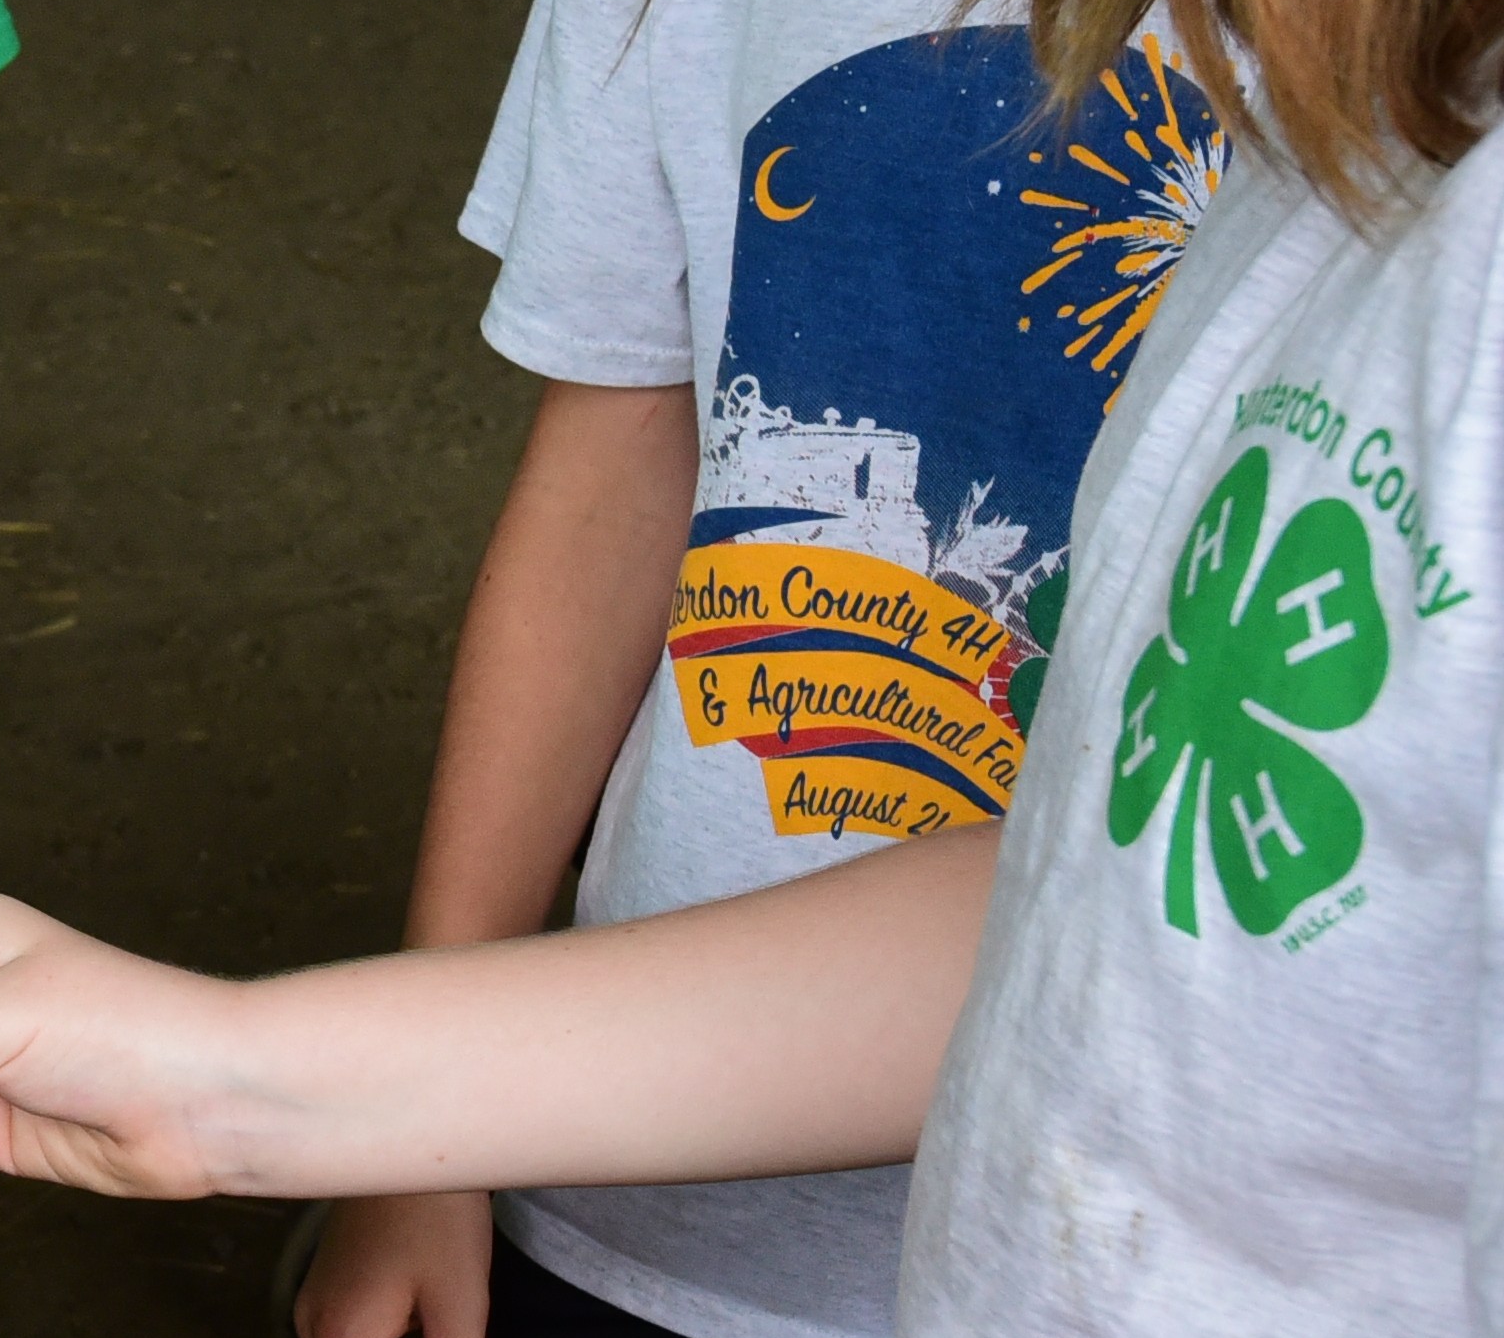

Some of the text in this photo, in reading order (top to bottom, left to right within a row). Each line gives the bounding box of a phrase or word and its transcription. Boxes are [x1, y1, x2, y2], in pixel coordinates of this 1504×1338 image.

[1235, 374, 1346, 459] terdon
[1185, 497, 1233, 597] H
[781, 566, 928, 651] County
[941, 614, 1005, 662] 4H
[1276, 568, 1356, 666] H
[699, 668, 727, 726] &
[748, 663, 986, 758] Agricultural
[1122, 688, 1157, 778] H
[784, 770, 908, 841] August
[1230, 770, 1305, 881] H
